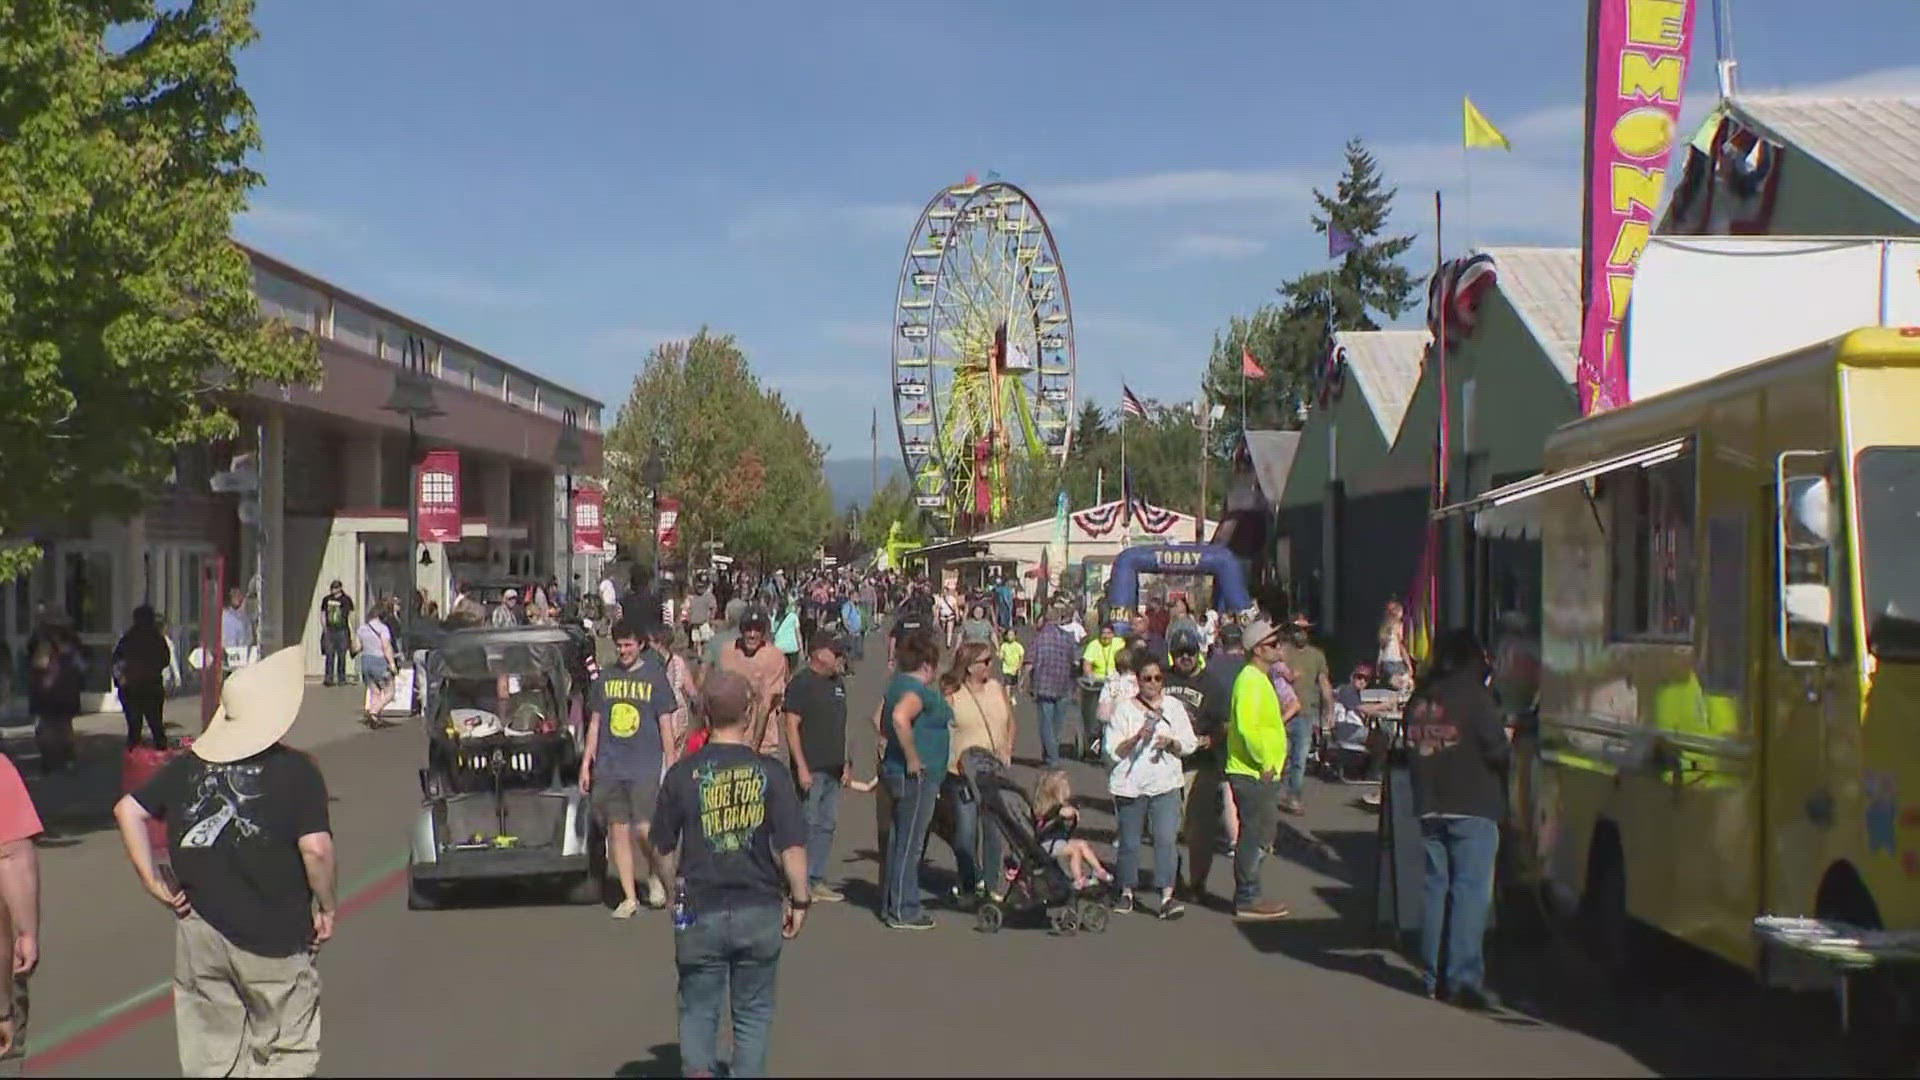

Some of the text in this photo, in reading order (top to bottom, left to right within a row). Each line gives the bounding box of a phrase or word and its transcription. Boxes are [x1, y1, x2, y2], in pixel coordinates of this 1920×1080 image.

[1602, 0, 1686, 372] EMONA
[1155, 551, 1201, 565] TODAY
[604, 679, 652, 702] NIRVANA
[703, 779, 761, 811] RIDE FOR
[701, 804, 765, 836] THE BRAND
